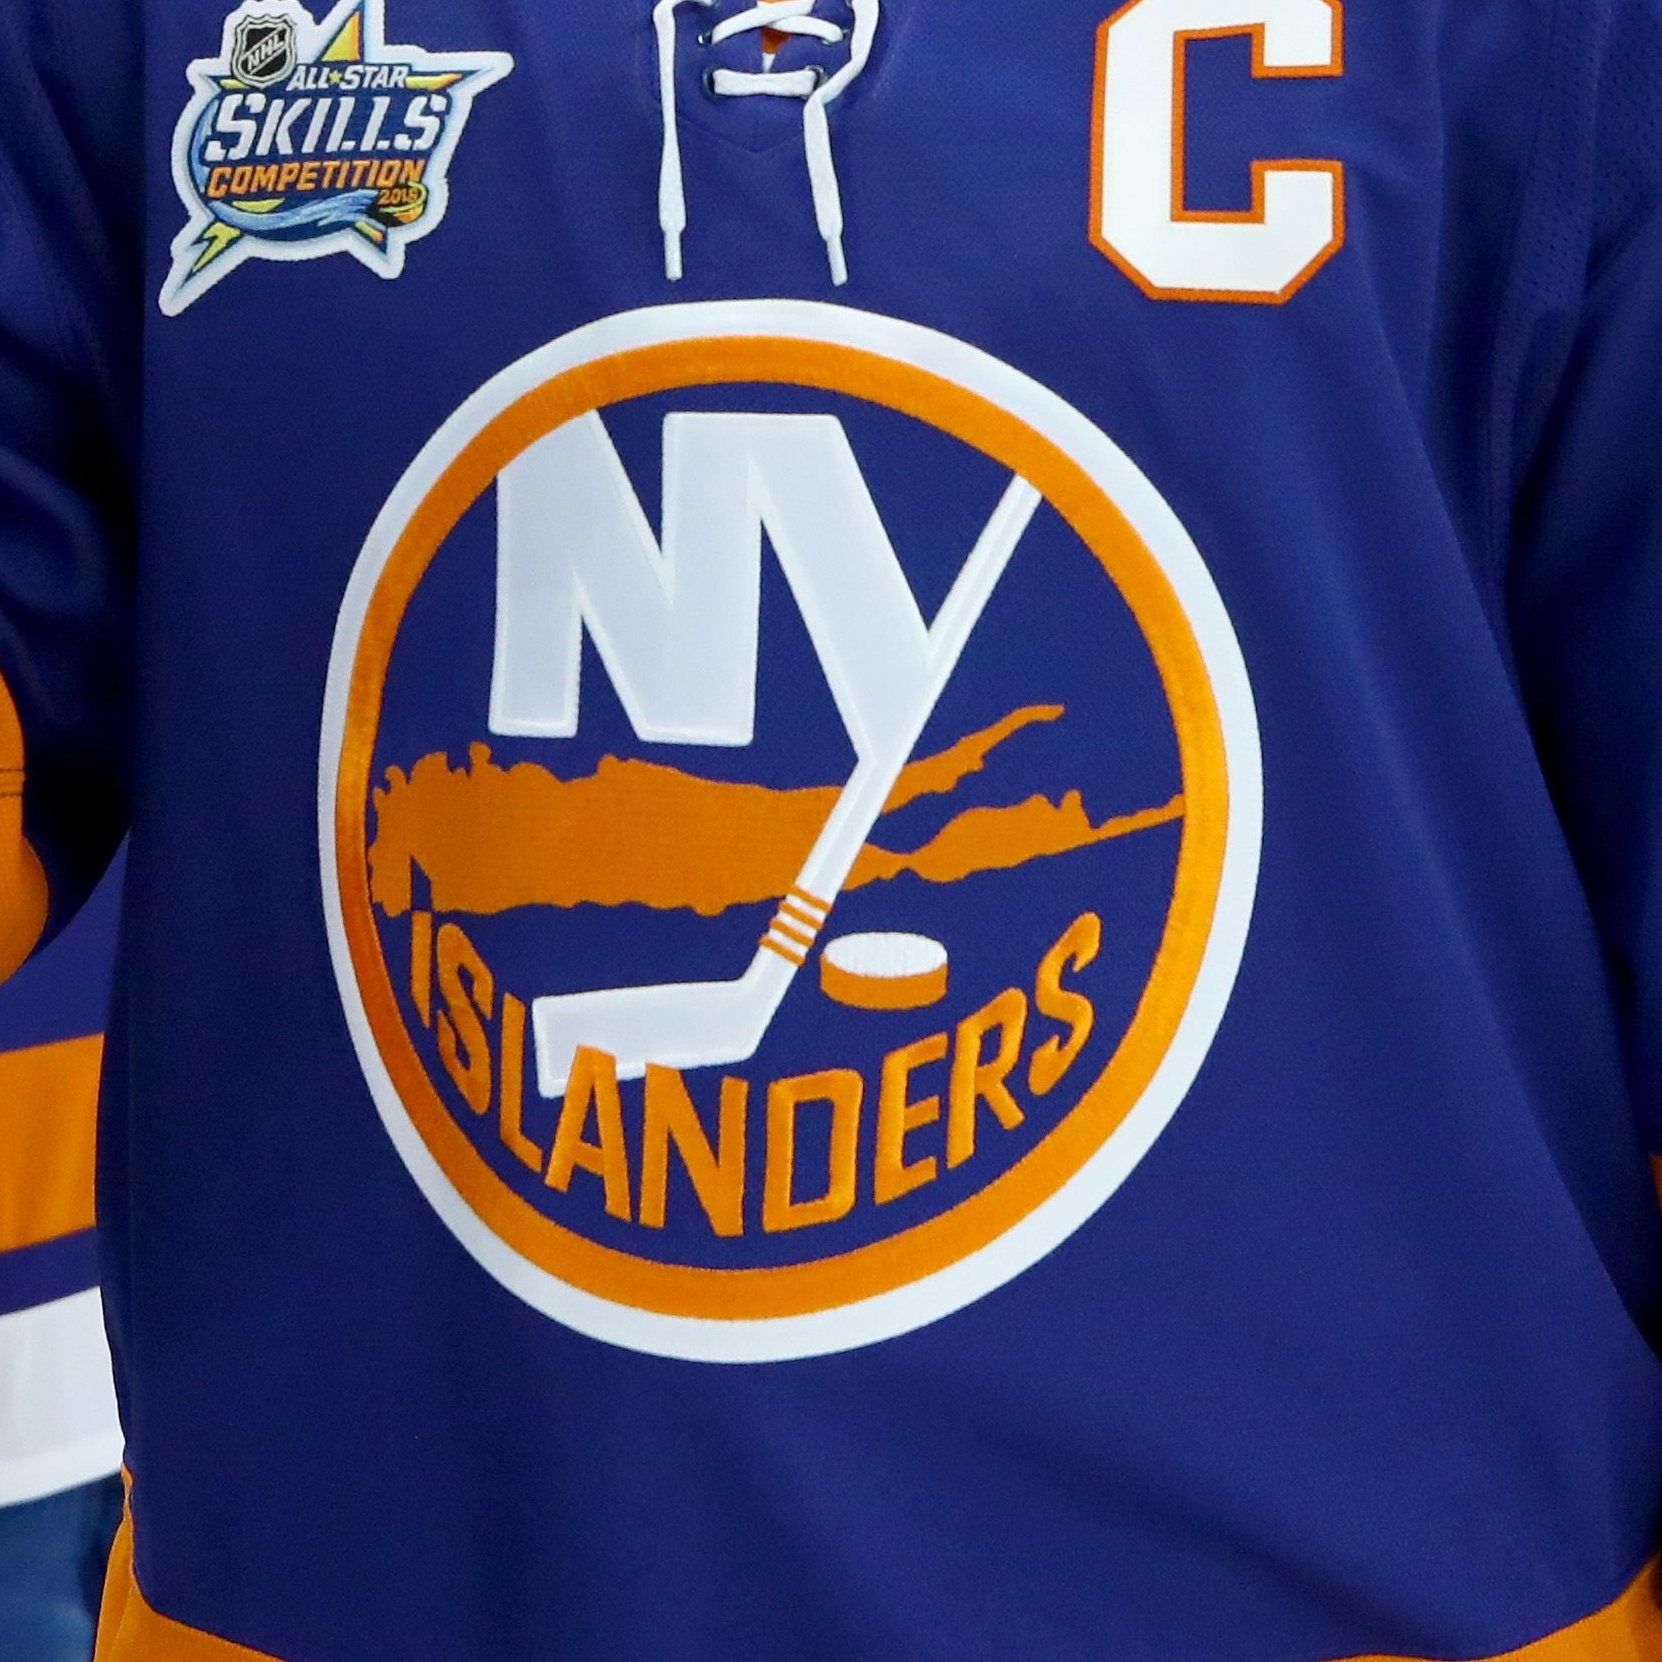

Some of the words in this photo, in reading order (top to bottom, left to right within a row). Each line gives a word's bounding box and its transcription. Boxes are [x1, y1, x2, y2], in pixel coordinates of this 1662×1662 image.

[245, 35, 285, 72] NHL
[204, 92, 448, 162] SKILLS
[205, 159, 426, 199] COMPETITION
[488, 408, 1041, 768] NY
[411, 909, 1100, 1236] ISLANDERS
